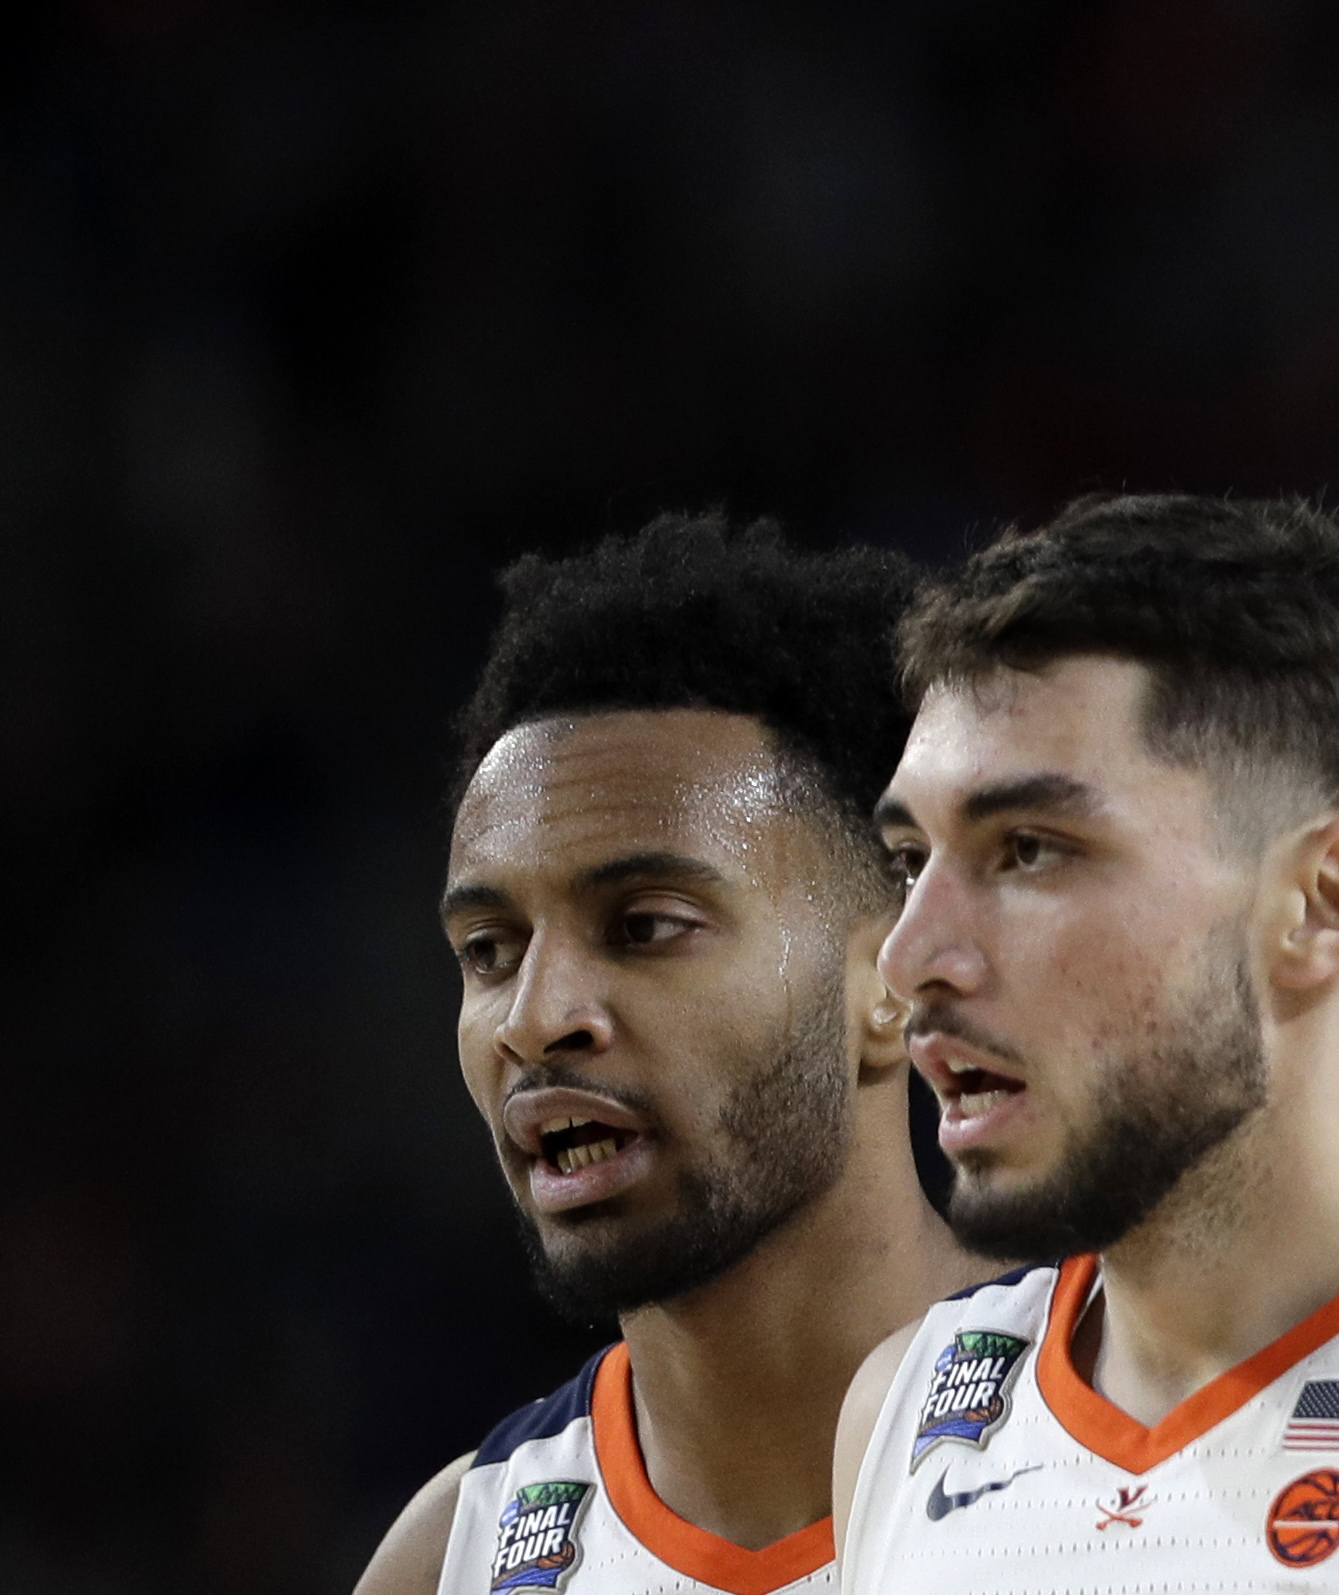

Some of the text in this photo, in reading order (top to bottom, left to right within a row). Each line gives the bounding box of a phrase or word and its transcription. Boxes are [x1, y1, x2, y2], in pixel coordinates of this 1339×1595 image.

[930, 1356, 1006, 1396] FINAL
[921, 1380, 997, 1427] FOUR
[499, 1502, 571, 1549] FINAL
[493, 1526, 565, 1579] FOUR
